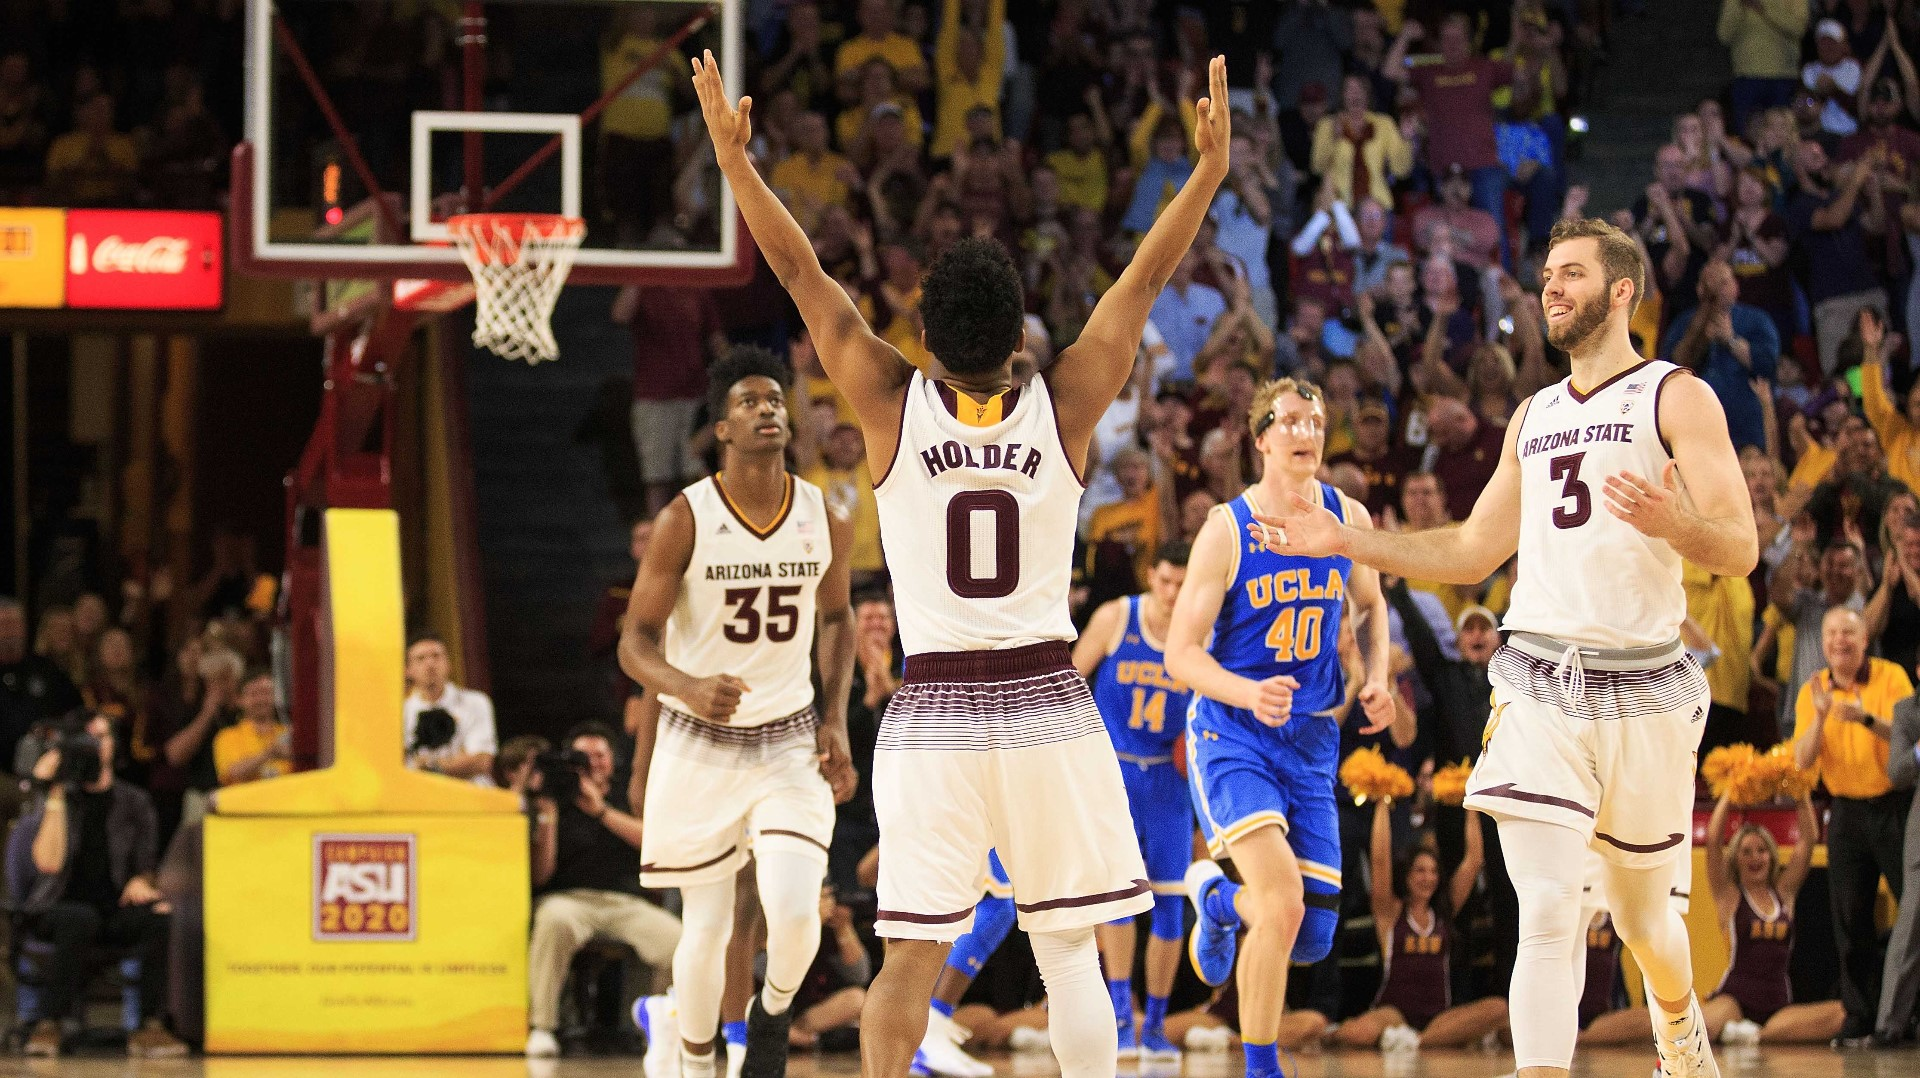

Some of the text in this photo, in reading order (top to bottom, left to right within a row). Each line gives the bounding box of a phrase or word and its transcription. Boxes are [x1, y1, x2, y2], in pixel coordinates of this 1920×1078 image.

[920, 440, 1042, 480] HOLDER
[1522, 423, 1635, 459] ARIZONA STATE
[1550, 451, 1592, 529] 3
[946, 489, 1020, 598] 0
[705, 561, 821, 580] ARIZONA STATE
[1246, 568, 1344, 609] UCLA
[723, 585, 803, 644] 35
[1265, 606, 1324, 662] 40
[1128, 688, 1168, 733] 14
[322, 862, 406, 902] ASU
[321, 903, 408, 931] 2020
